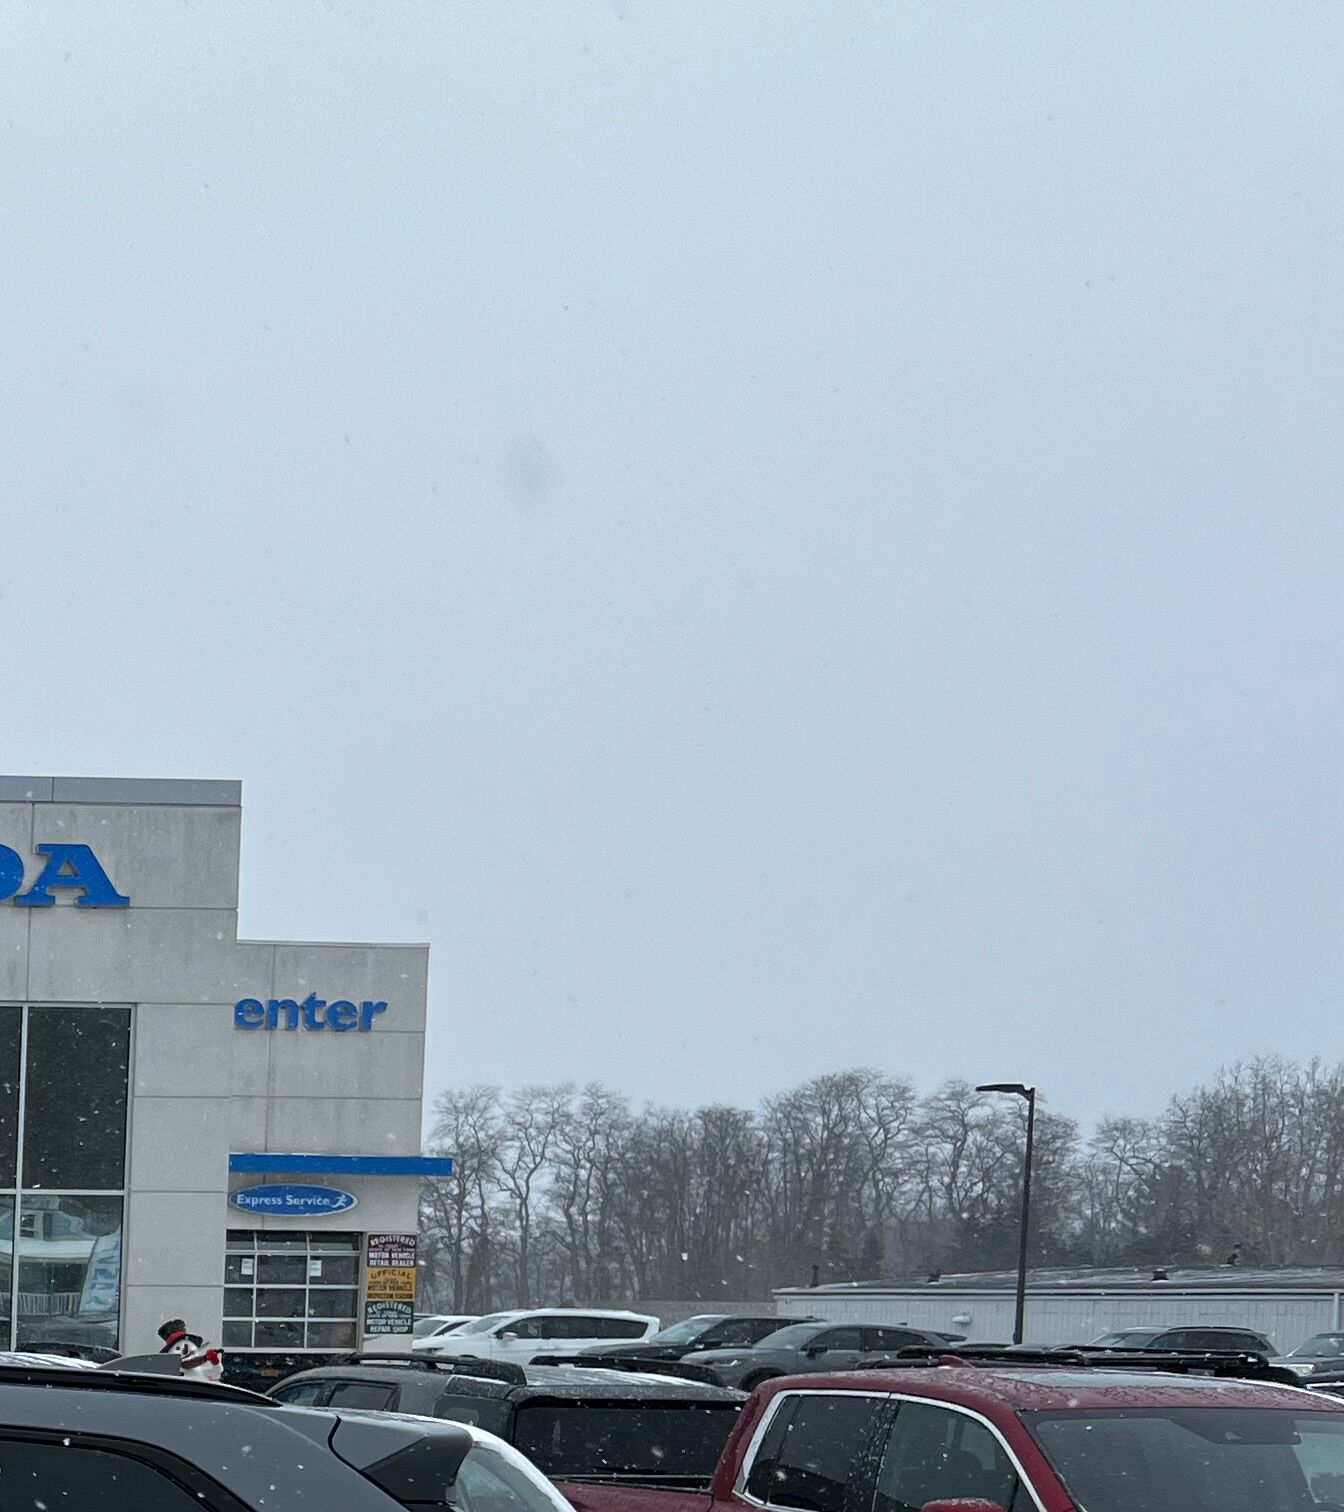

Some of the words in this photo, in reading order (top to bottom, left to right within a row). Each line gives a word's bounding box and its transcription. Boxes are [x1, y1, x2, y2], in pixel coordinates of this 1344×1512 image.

[234, 992, 388, 1031] enter
[236, 1194, 282, 1207] Express
[286, 1195, 330, 1205] Service
[370, 1235, 415, 1246] REGISTERED
[370, 1269, 411, 1279] OFFICIAL
[367, 1302, 411, 1313] REGISTERED
